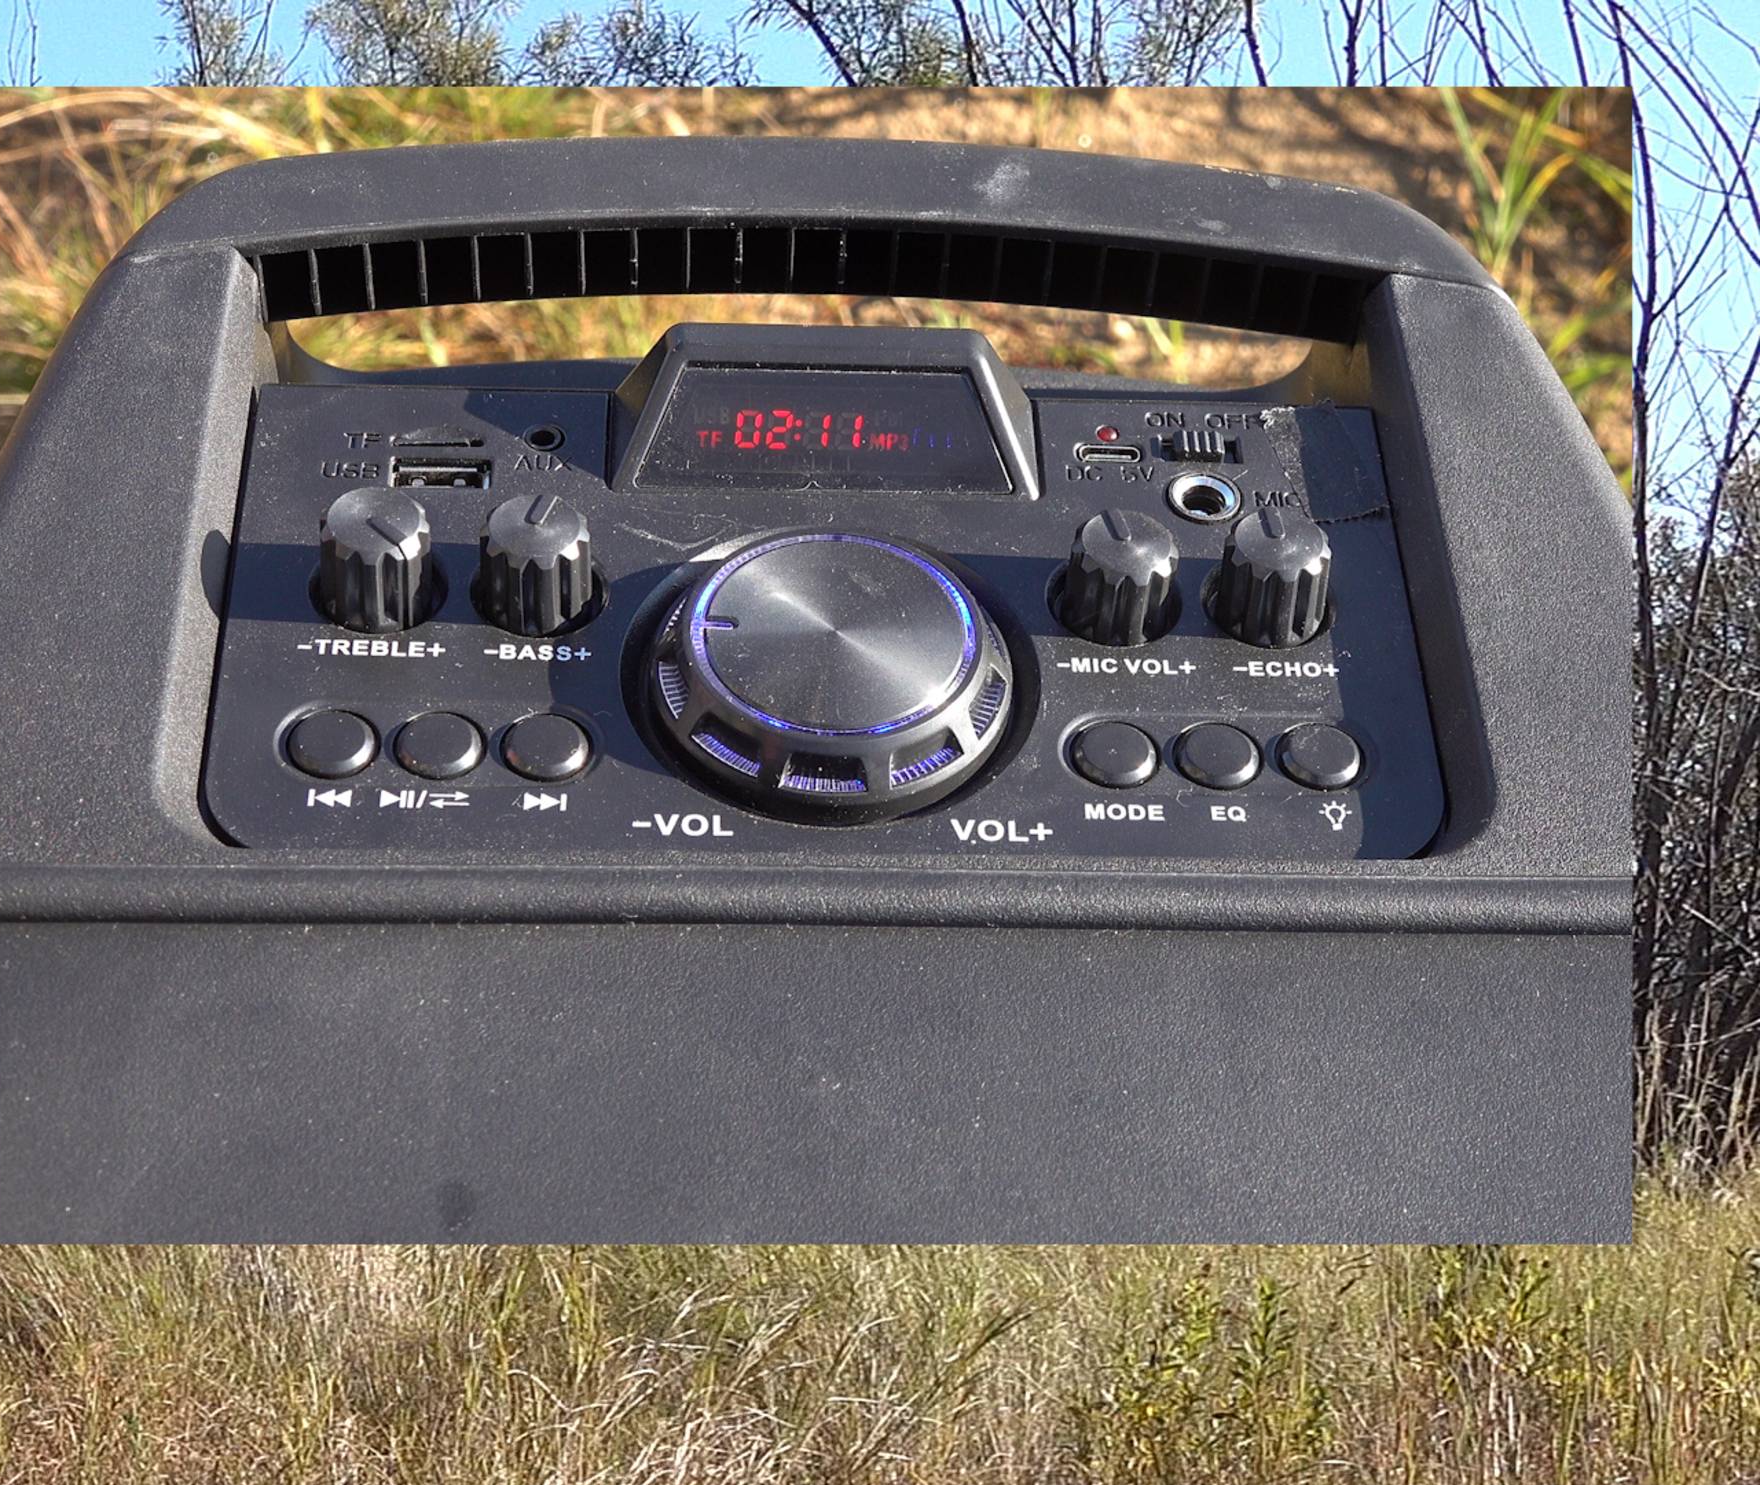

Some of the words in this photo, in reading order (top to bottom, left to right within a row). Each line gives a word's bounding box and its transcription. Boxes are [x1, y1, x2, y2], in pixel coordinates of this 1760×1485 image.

[1143, 410, 1186, 428] ON
[1203, 411, 1265, 430] OFF
[696, 430, 723, 449] TF
[734, 409, 865, 450] 02:11
[868, 432, 910, 451] MP3
[342, 431, 381, 449] TF
[320, 460, 381, 479] USB
[513, 454, 574, 472] AUX
[1064, 464, 1103, 482] DC
[1119, 464, 1154, 482] 5V
[1252, 490, 1301, 508] MIC
[296, 638, 447, 658] -TREBLE+
[483, 643, 592, 662] -BASS+
[1056, 656, 1118, 675] -MIC
[1122, 657, 1197, 677] VOL+
[1232, 660, 1340, 678] -ECHO+
[1083, 803, 1166, 822] MODE
[1210, 805, 1247, 822] EQ
[631, 813, 735, 837] -VOL
[950, 818, 1054, 843] VOL+
